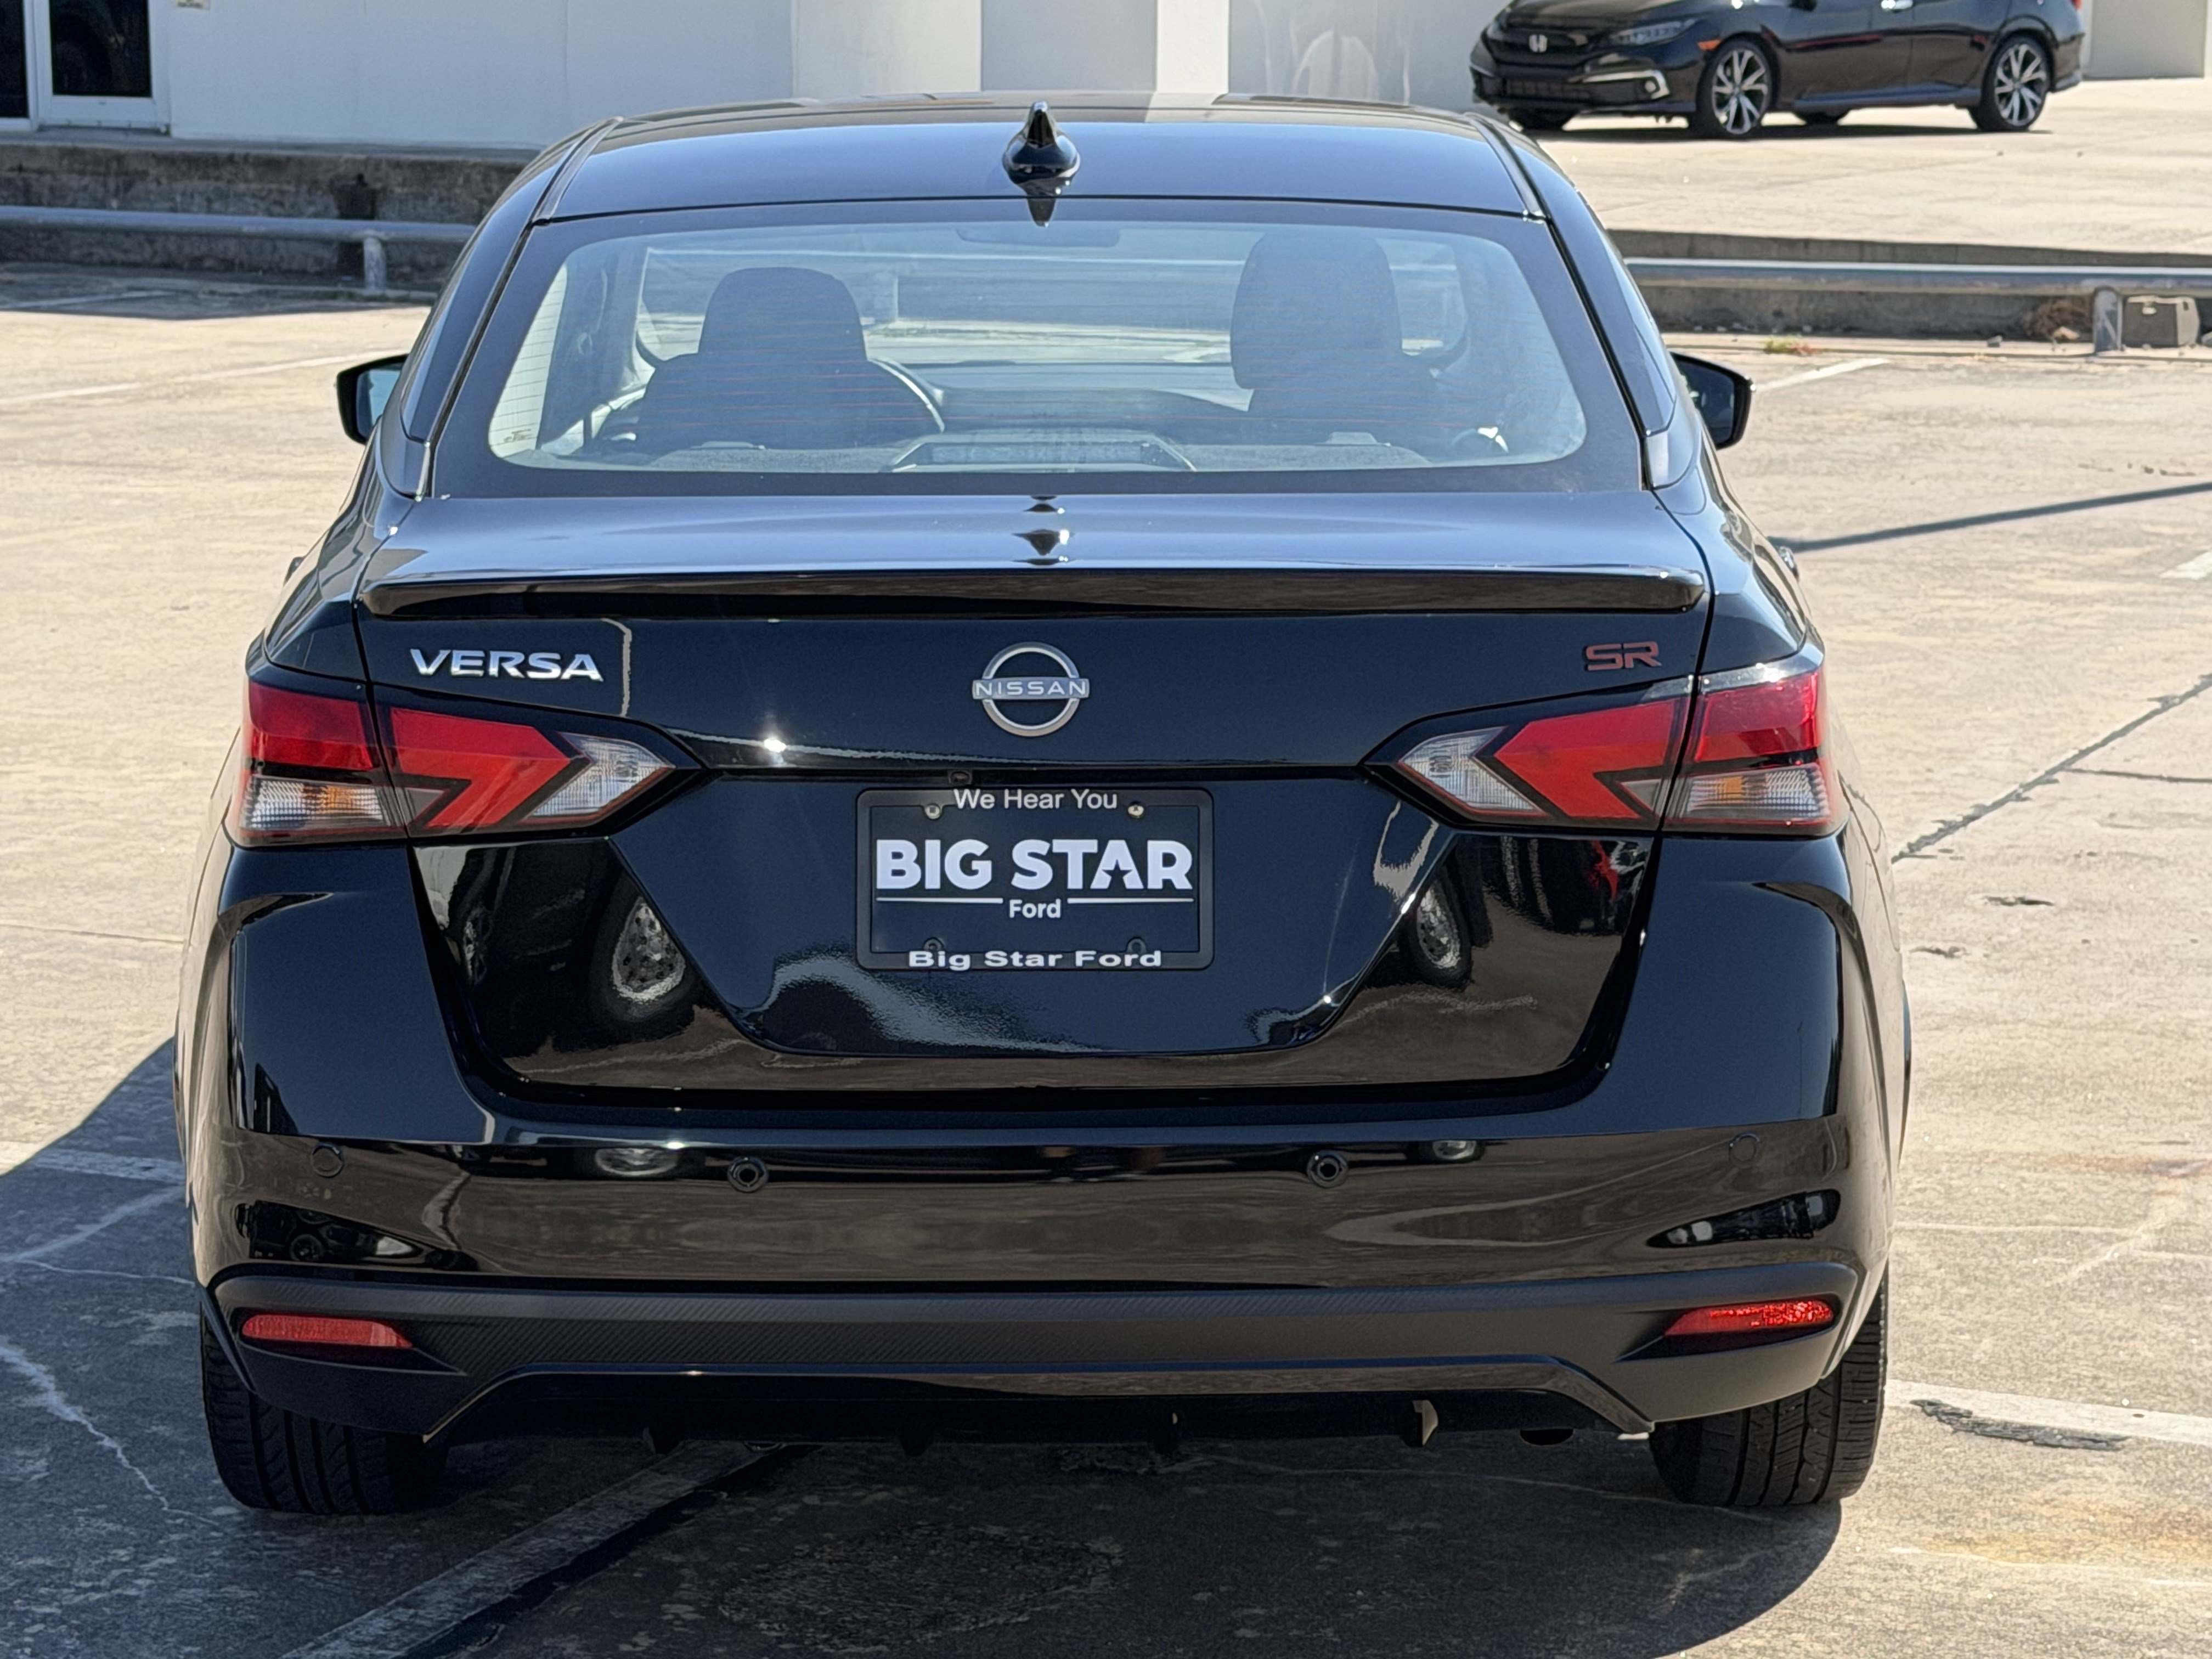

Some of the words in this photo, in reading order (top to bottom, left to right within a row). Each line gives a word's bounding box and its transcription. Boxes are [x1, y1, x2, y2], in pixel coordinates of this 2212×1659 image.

[410, 648, 603, 682] VERSA
[1585, 641, 1662, 671] SR
[975, 681, 1086, 696] NISSAN
[953, 789, 995, 809] We
[1004, 789, 1065, 809] Hear
[1071, 789, 1118, 809] You
[876, 839, 992, 890] BIG
[1011, 839, 1193, 890] STAR
[1009, 898, 1062, 919] Ford
[909, 951, 971, 971] Big
[984, 951, 1063, 967] Star
[1075, 950, 1162, 967] Ford
